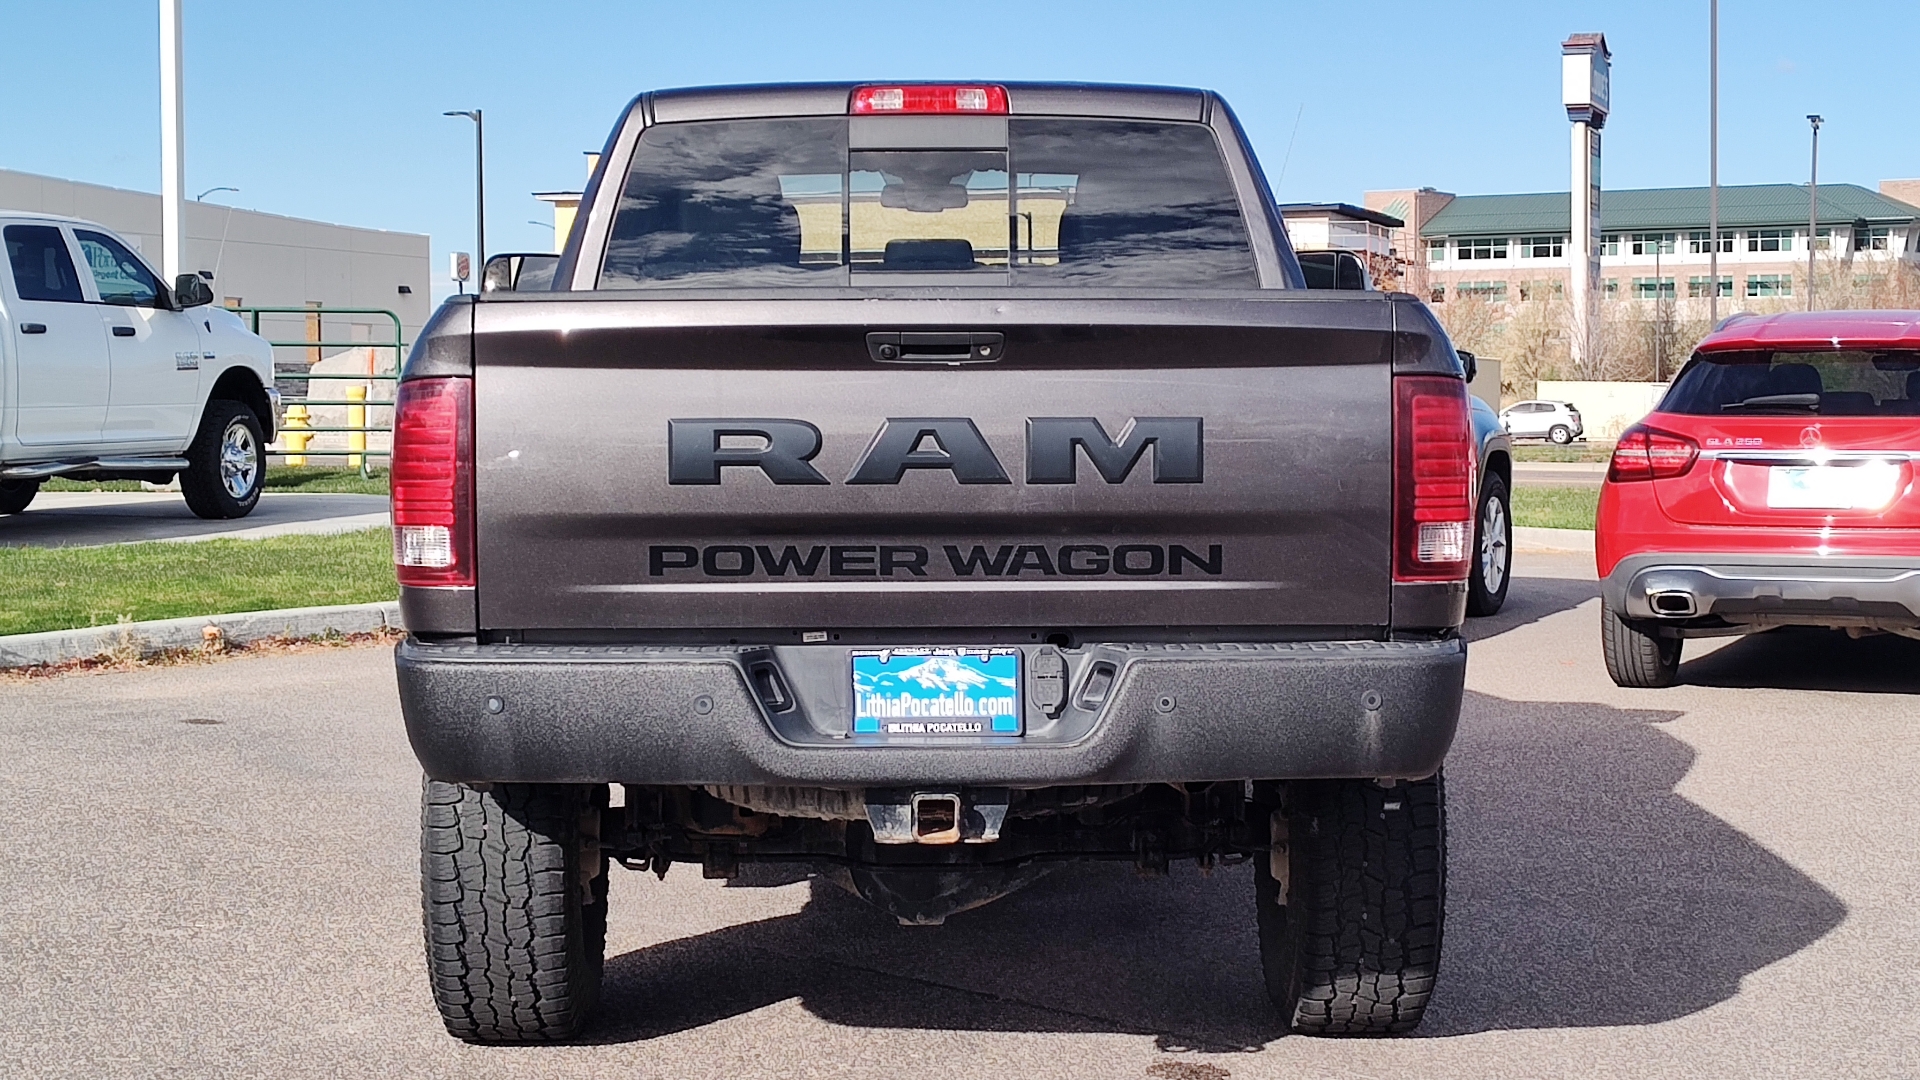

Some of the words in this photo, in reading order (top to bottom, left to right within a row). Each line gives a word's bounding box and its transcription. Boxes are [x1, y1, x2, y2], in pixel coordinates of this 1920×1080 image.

[668, 417, 1204, 485] RAM
[649, 545, 929, 577] POWER
[943, 545, 1223, 576] WAGON
[855, 691, 1014, 718] LithiaPocatello.com
[926, 722, 982, 733] POCATELLO
